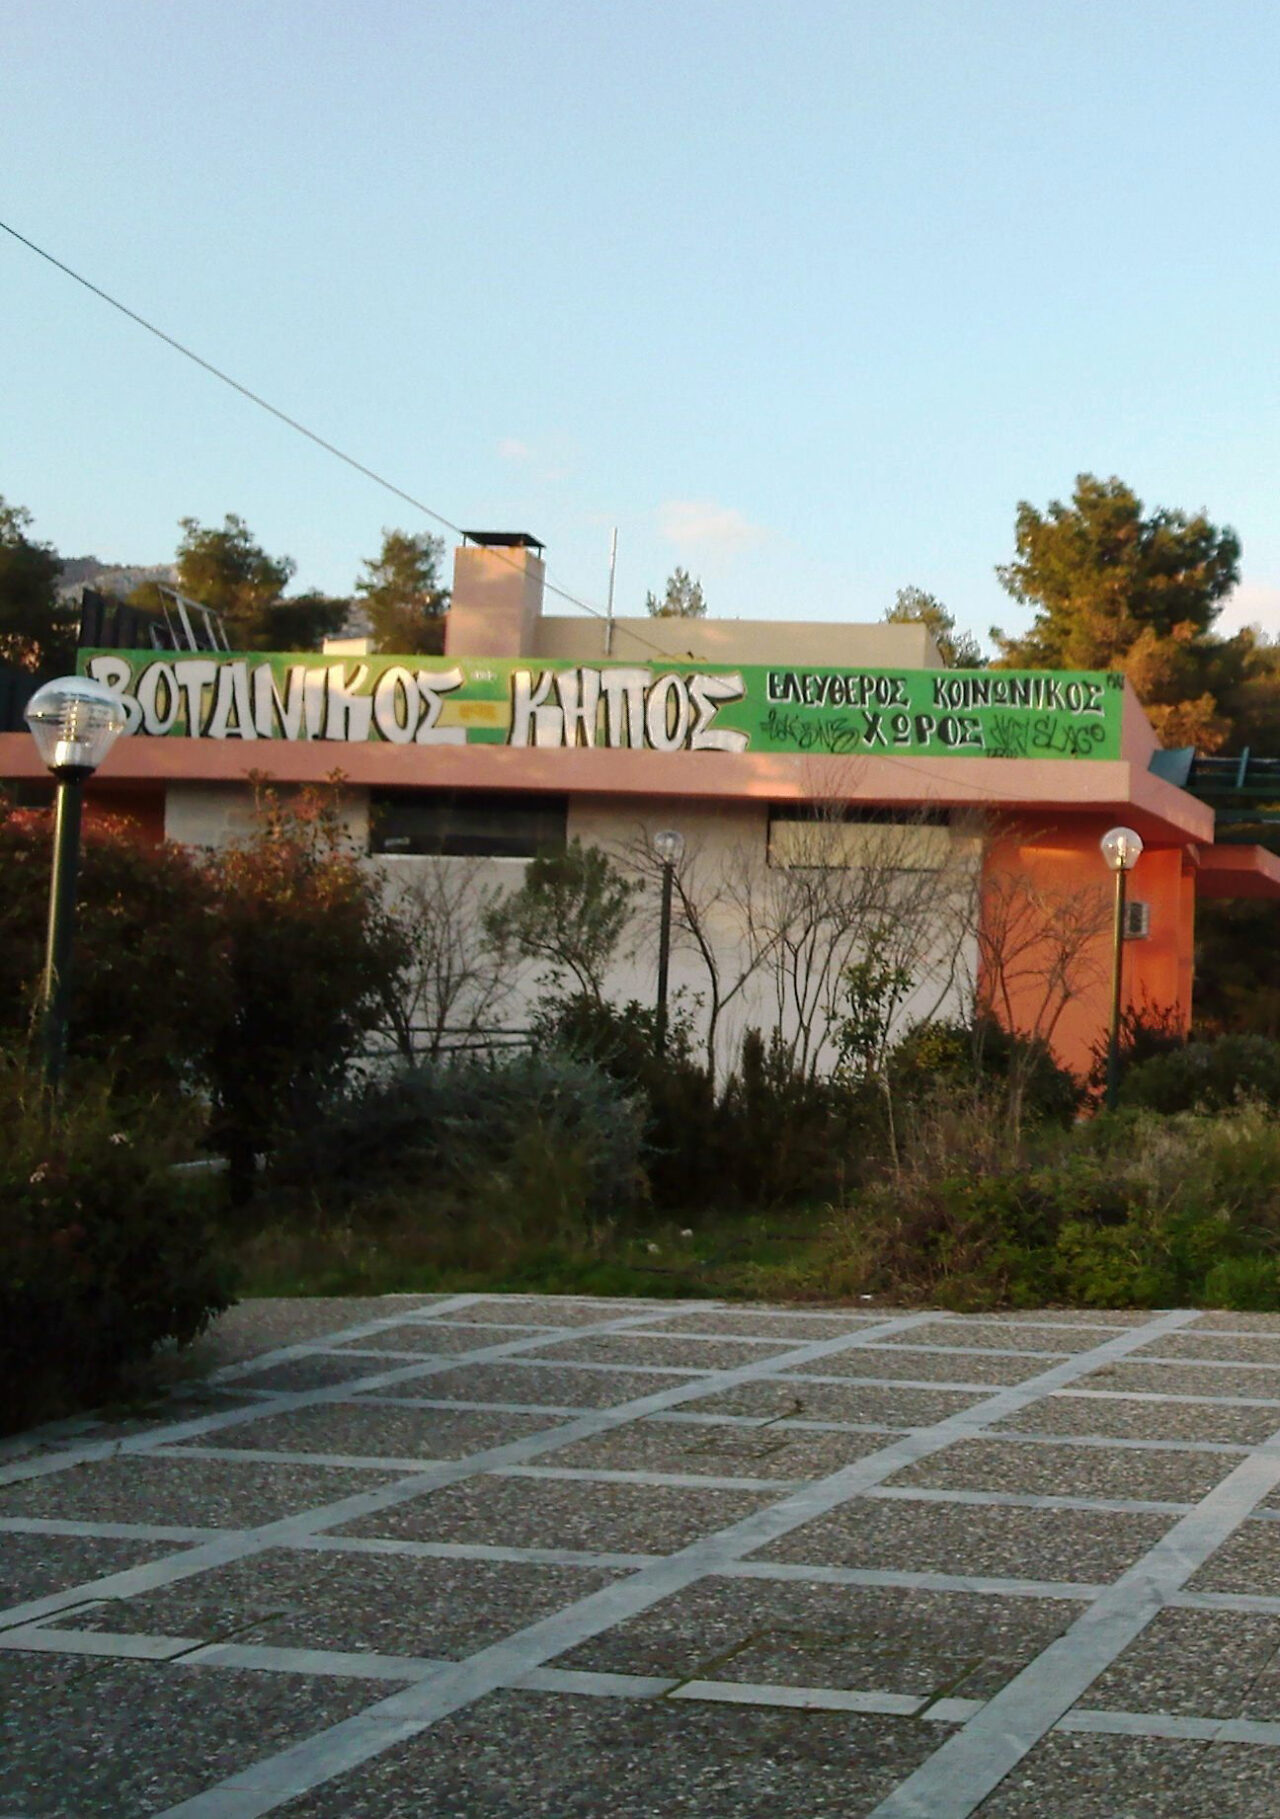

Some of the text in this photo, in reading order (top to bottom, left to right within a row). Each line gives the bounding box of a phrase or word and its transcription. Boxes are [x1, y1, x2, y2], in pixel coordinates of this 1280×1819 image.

[88, 655, 466, 745] ΒΟΤΑΝΙΚΟΣ
[511, 667, 750, 753] ΚΗΠΟΣ
[766, 672, 911, 709] ΕΛΕΥΘΕΡΟΣ
[933, 676, 1105, 716] ΚΟΙΝΩΝΙΚΟΣ
[862, 711, 985, 748] ΧΩΡΟΣ
